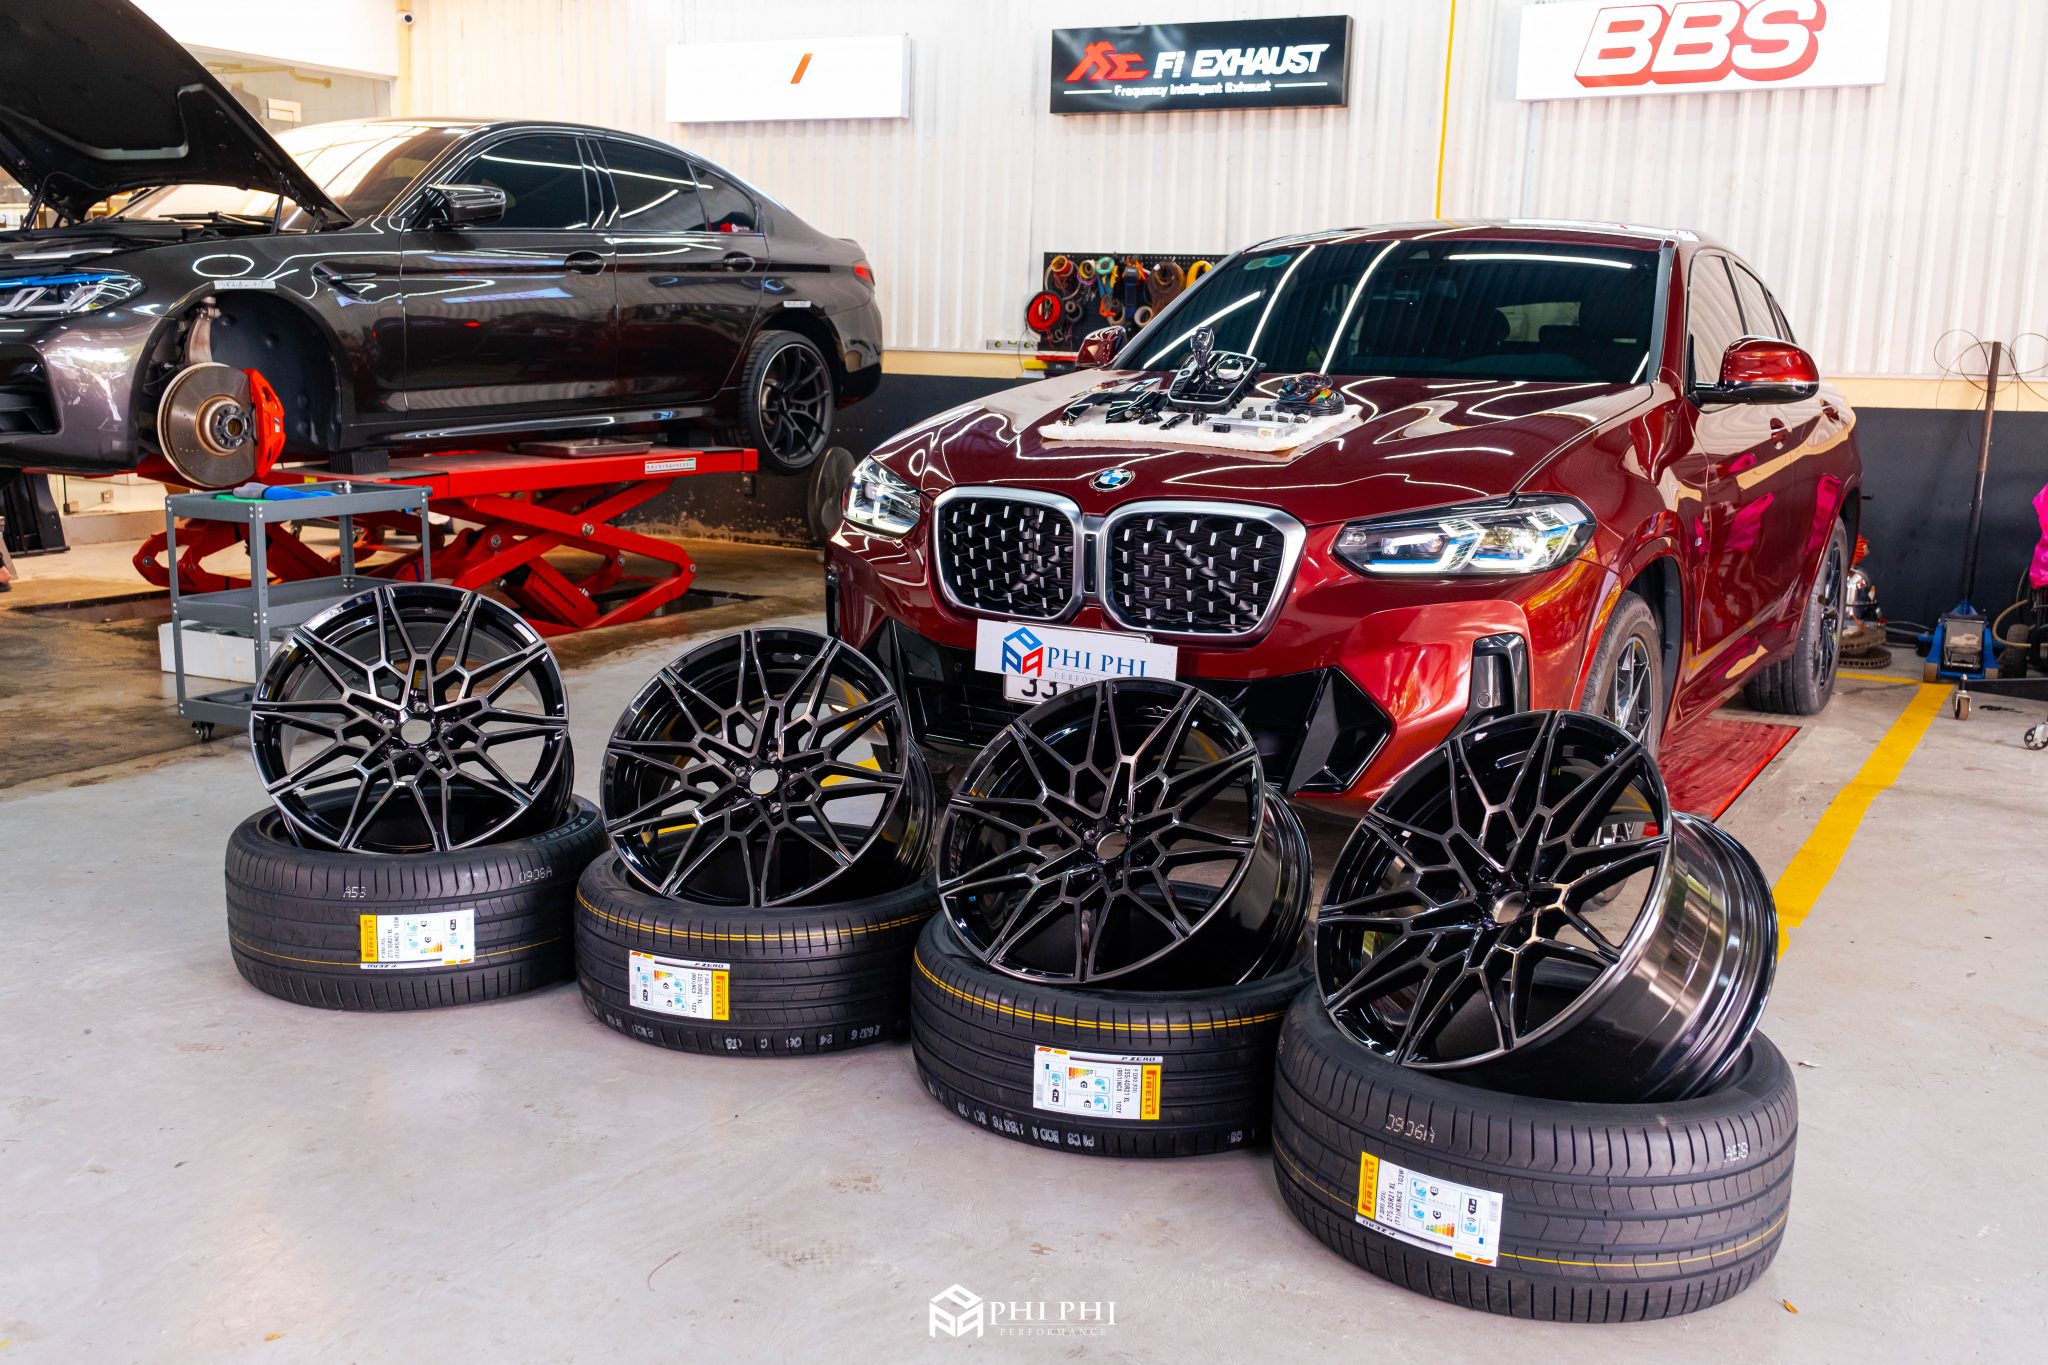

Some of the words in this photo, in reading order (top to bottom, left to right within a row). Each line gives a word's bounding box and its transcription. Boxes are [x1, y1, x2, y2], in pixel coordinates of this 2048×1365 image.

[1191, 43, 1330, 78] EXHAUST
[1574, 0, 1827, 88] BBS
[1114, 84, 1169, 97] Frequency
[1170, 81, 1223, 95] Intelligent
[1224, 80, 1272, 93] Exhaust
[1047, 646, 1092, 670] PHI
[1100, 653, 1147, 677] PHI
[363, 919, 375, 958] PIRELLI
[716, 975, 726, 1016] PIRELLI
[1145, 1069, 1157, 1115] PIRELLI
[1361, 1158, 1375, 1212] PIRELLI
[1362, 1220, 1387, 1234] ZERO
